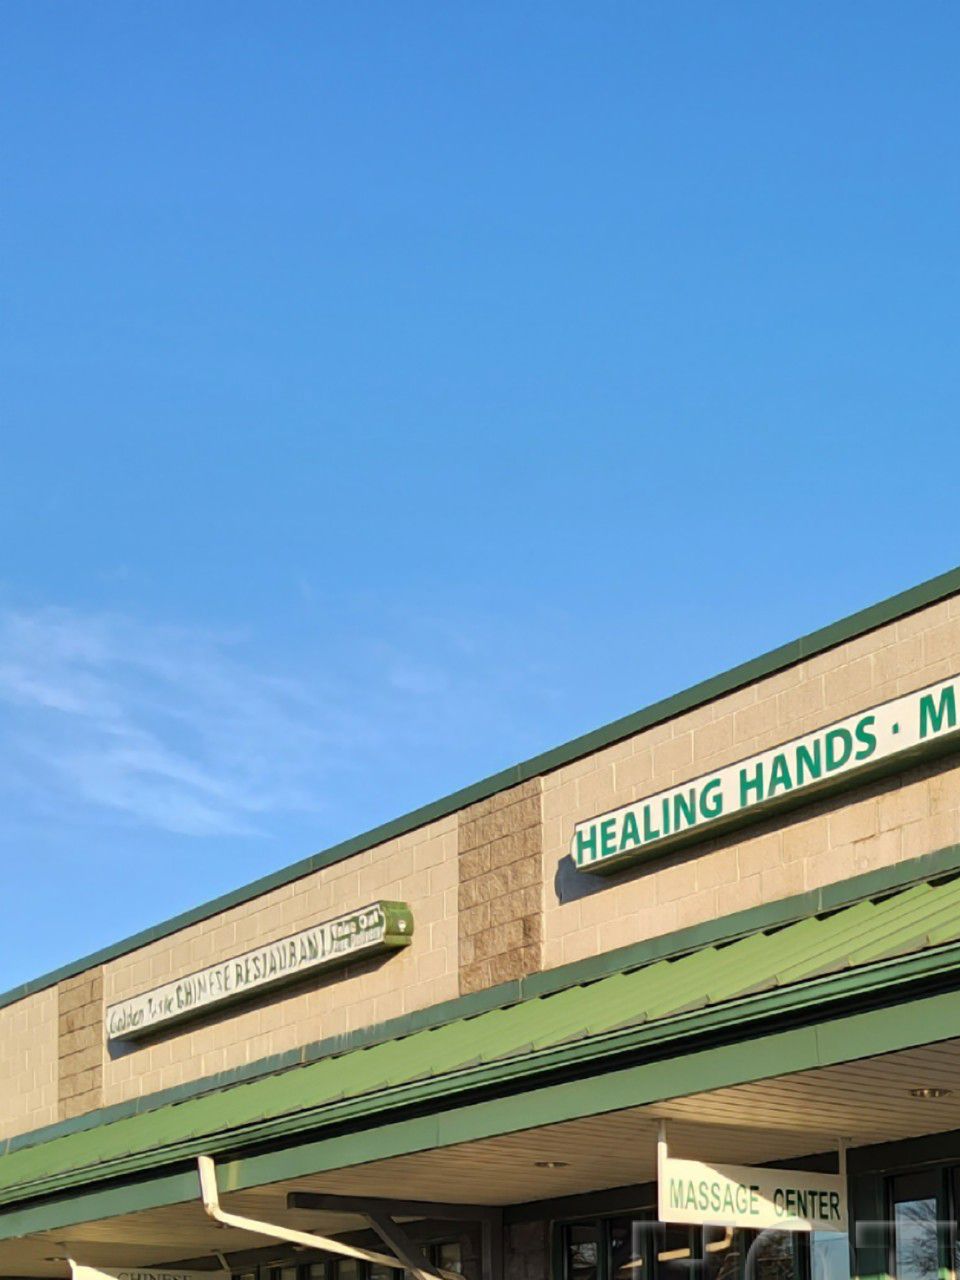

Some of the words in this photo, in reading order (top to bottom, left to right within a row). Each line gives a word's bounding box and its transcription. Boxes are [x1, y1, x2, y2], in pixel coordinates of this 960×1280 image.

[576, 779, 724, 866] HEALING
[739, 715, 877, 808] HANDS
[176, 964, 231, 1009] CHINESE
[234, 929, 326, 987] RESTAURANT
[669, 1178, 761, 1217] MASSAGE
[773, 1188, 841, 1221] CENTER
